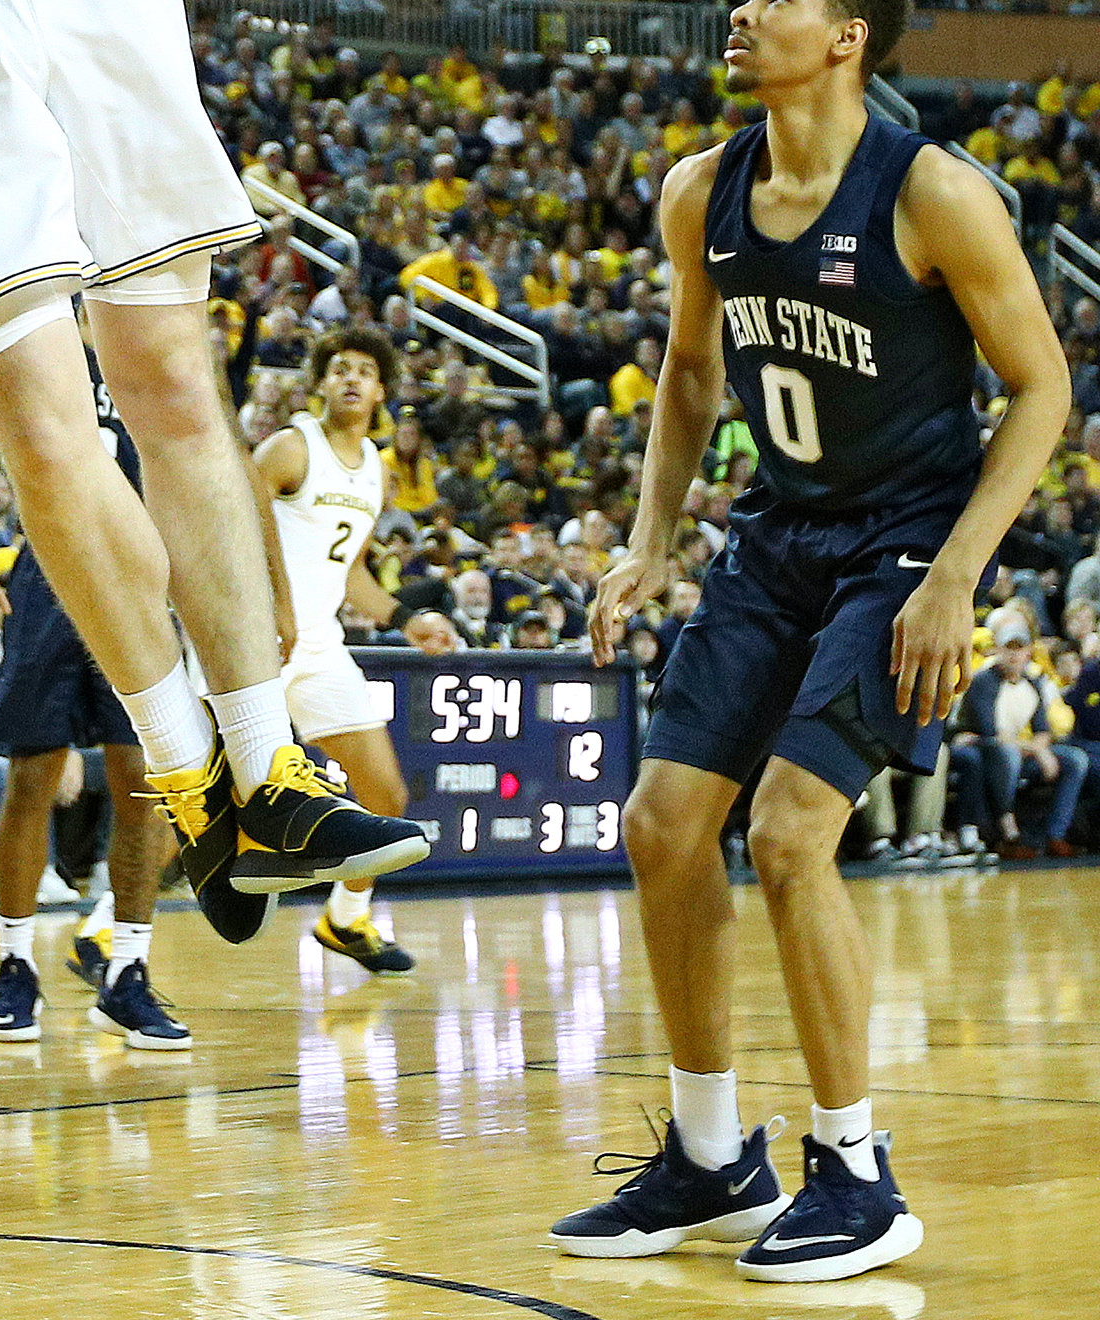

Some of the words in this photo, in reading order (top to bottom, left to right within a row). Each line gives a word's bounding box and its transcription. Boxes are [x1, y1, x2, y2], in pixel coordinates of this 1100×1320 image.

[723, 296, 775, 351] ENN
[776, 297, 879, 378] STATE
[760, 362, 823, 463] 0
[327, 521, 353, 564] 2
[431, 675, 522, 743] 5:34
[460, 807, 479, 852] 1
[539, 802, 565, 853] 3
[596, 800, 620, 852] 3
